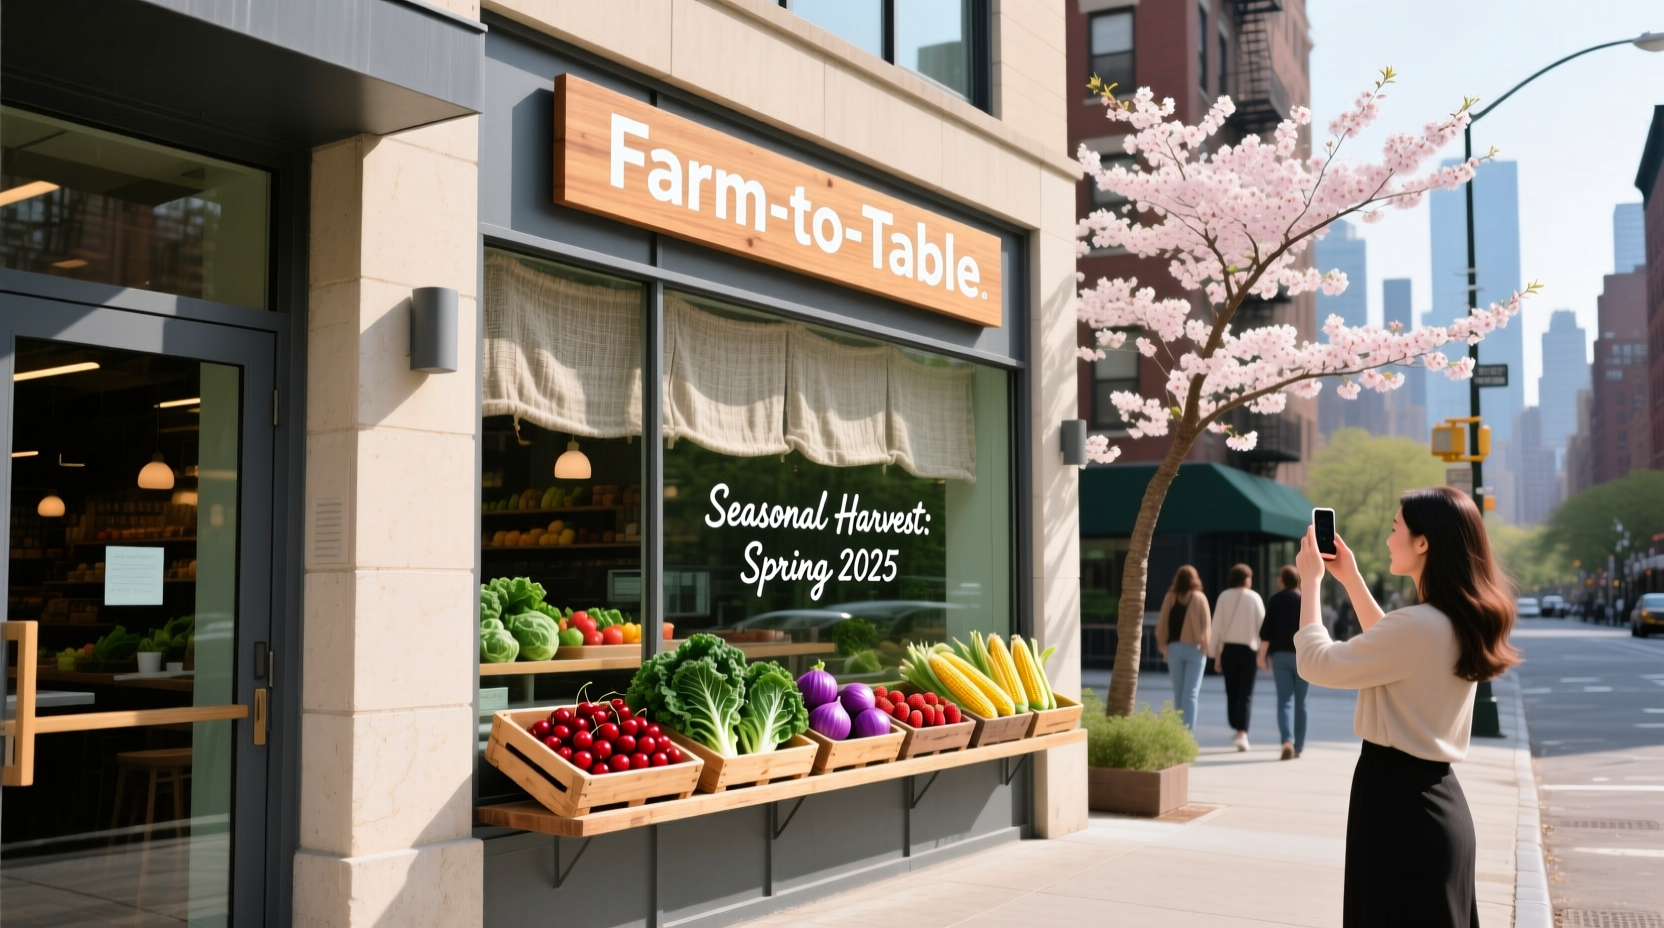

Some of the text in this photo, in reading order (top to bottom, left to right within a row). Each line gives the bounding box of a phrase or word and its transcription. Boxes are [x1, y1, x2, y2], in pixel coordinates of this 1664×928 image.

[704, 483, 931, 536] Seasonal Harvest:
[740, 540, 900, 601] Spring 2025
